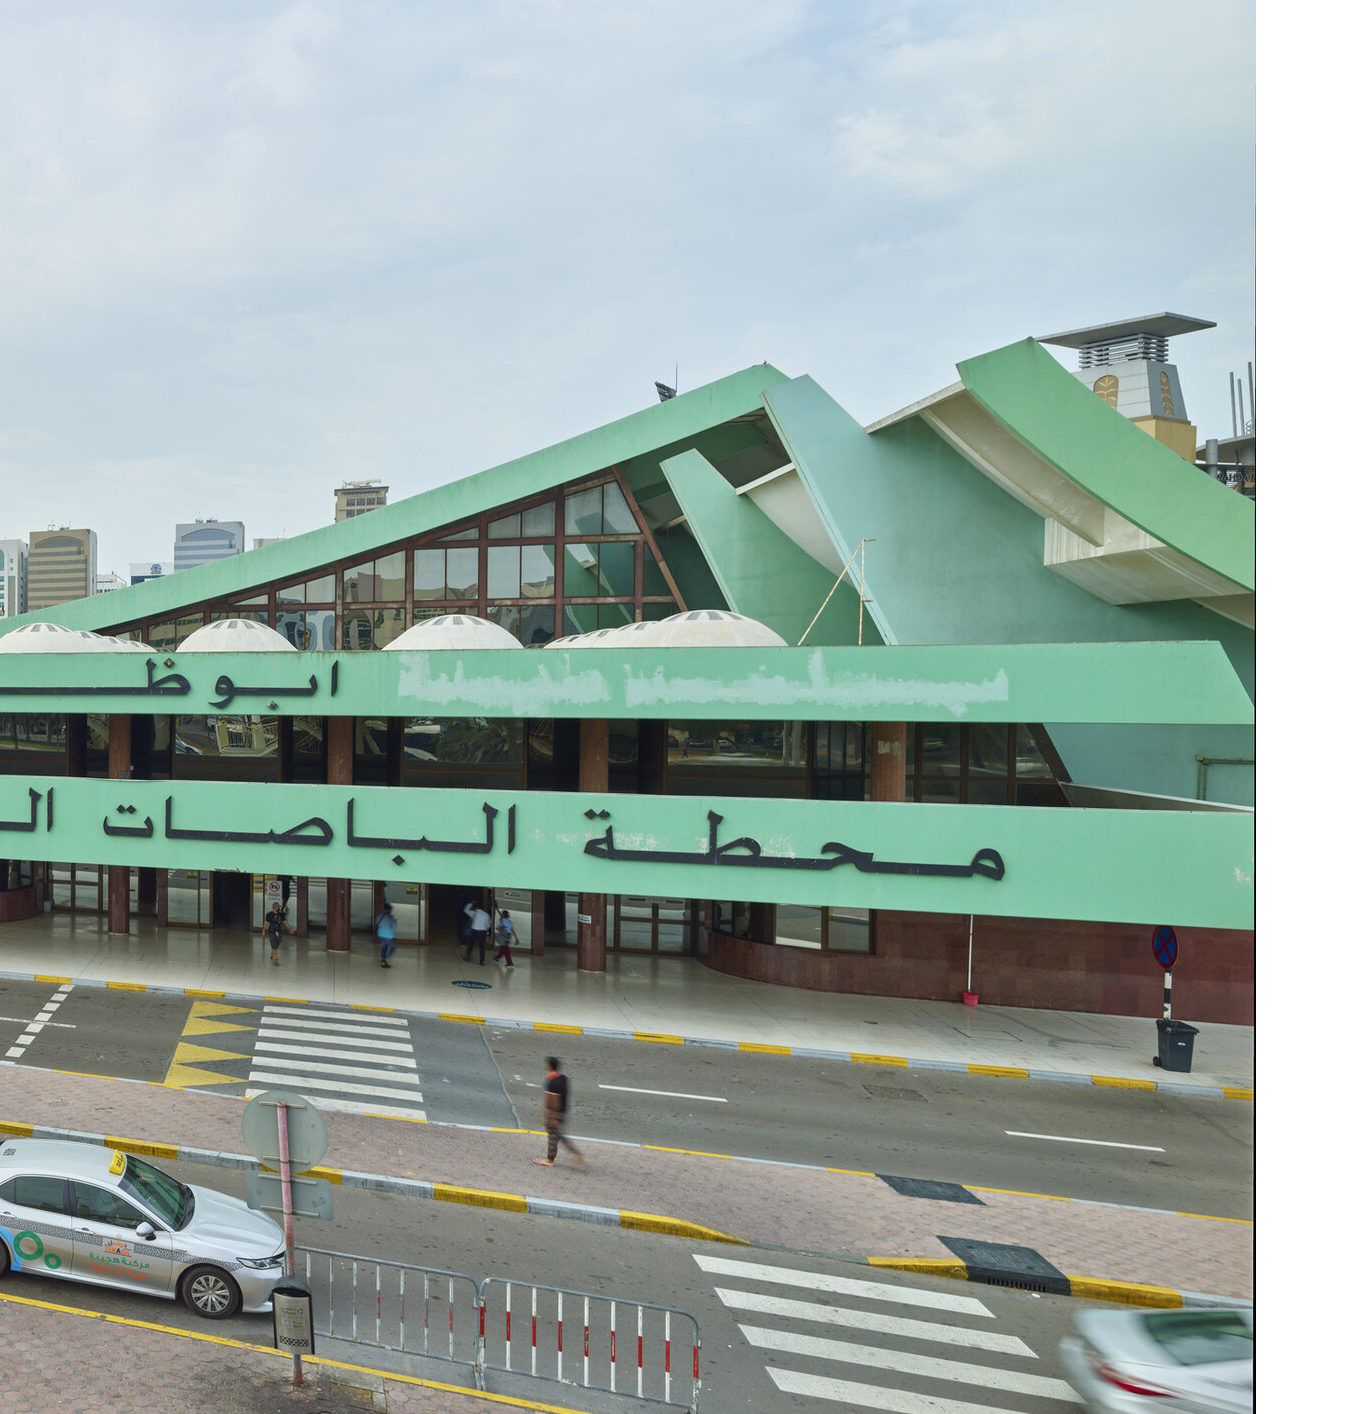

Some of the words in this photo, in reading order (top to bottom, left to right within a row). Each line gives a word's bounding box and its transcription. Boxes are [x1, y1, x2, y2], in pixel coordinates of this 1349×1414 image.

[102, 795, 517, 867] الباصات
[583, 808, 1006, 882] محطة
[90, 1263, 123, 1276] Hybrid
[125, 1269, 148, 1280] Taxi
